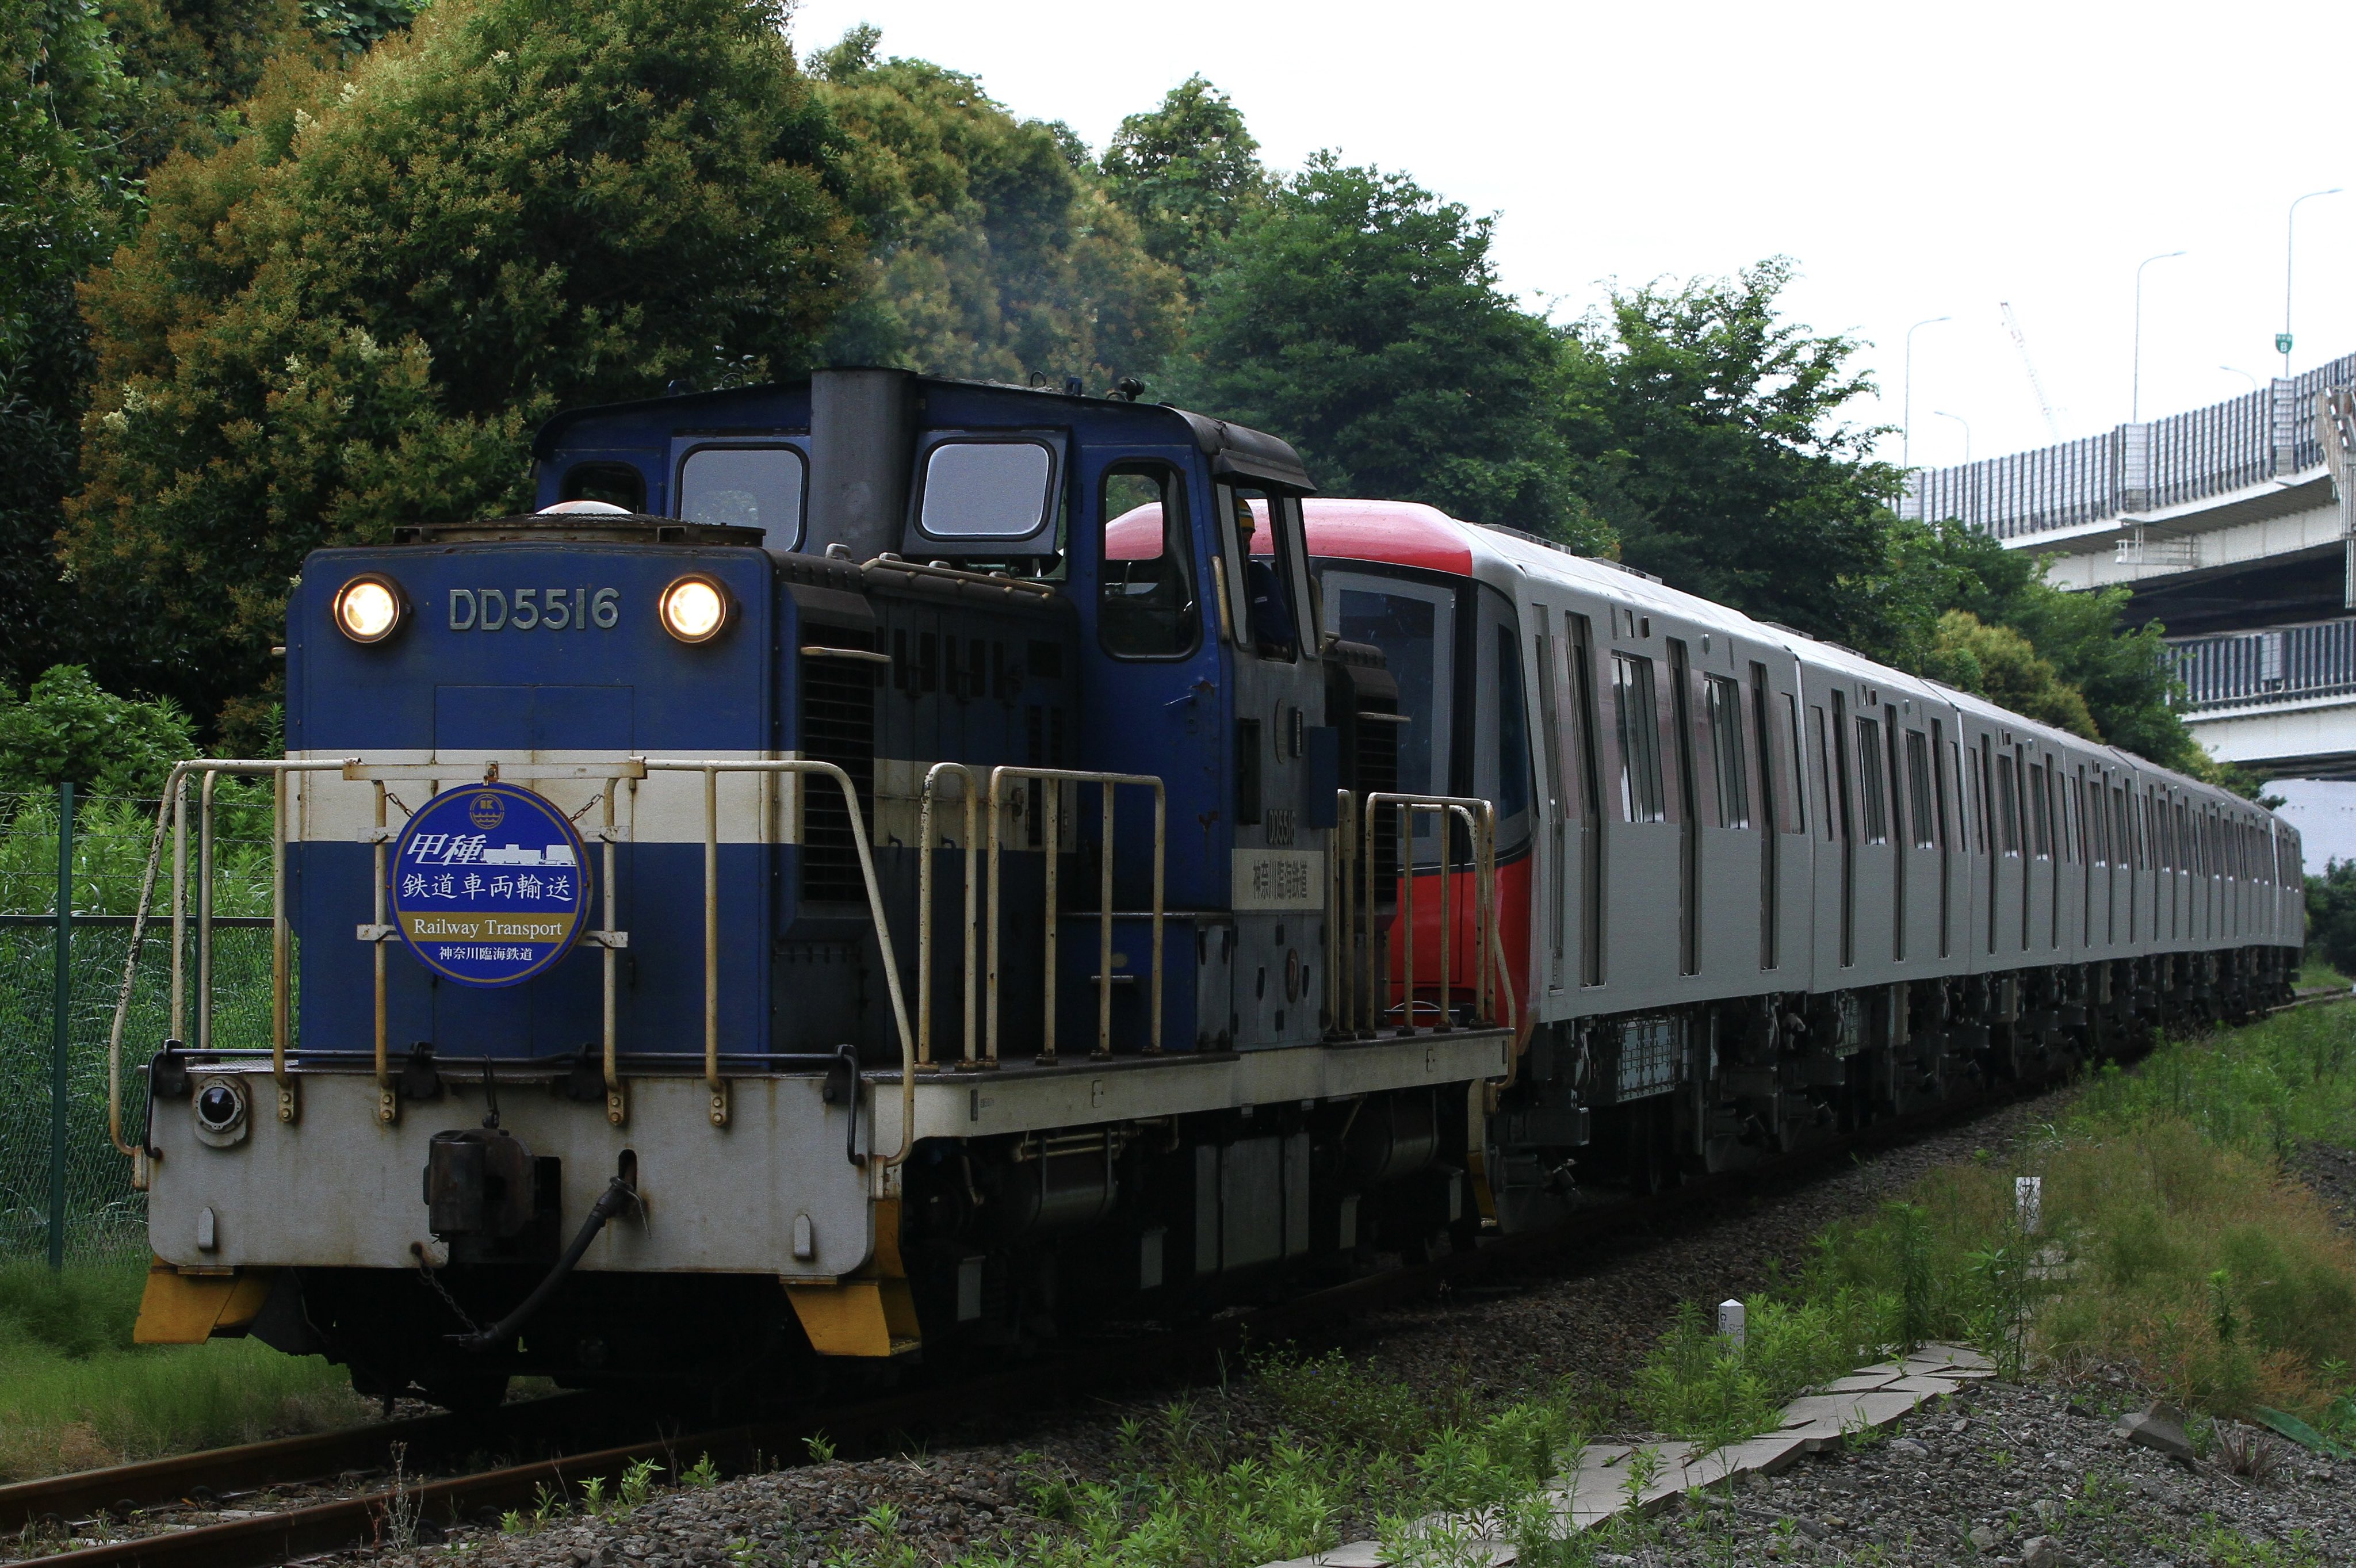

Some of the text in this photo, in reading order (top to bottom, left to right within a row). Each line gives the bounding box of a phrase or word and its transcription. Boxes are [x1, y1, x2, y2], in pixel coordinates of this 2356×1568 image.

[449, 587, 619, 630] DD5516
[1268, 809, 1296, 845] DD5516
[407, 832, 487, 866] 甲種
[402, 873, 573, 902] 鉄道車両輸送
[414, 918, 562, 939] Railway Transport
[439, 946, 533, 962] 神奈川臨海鉄道
